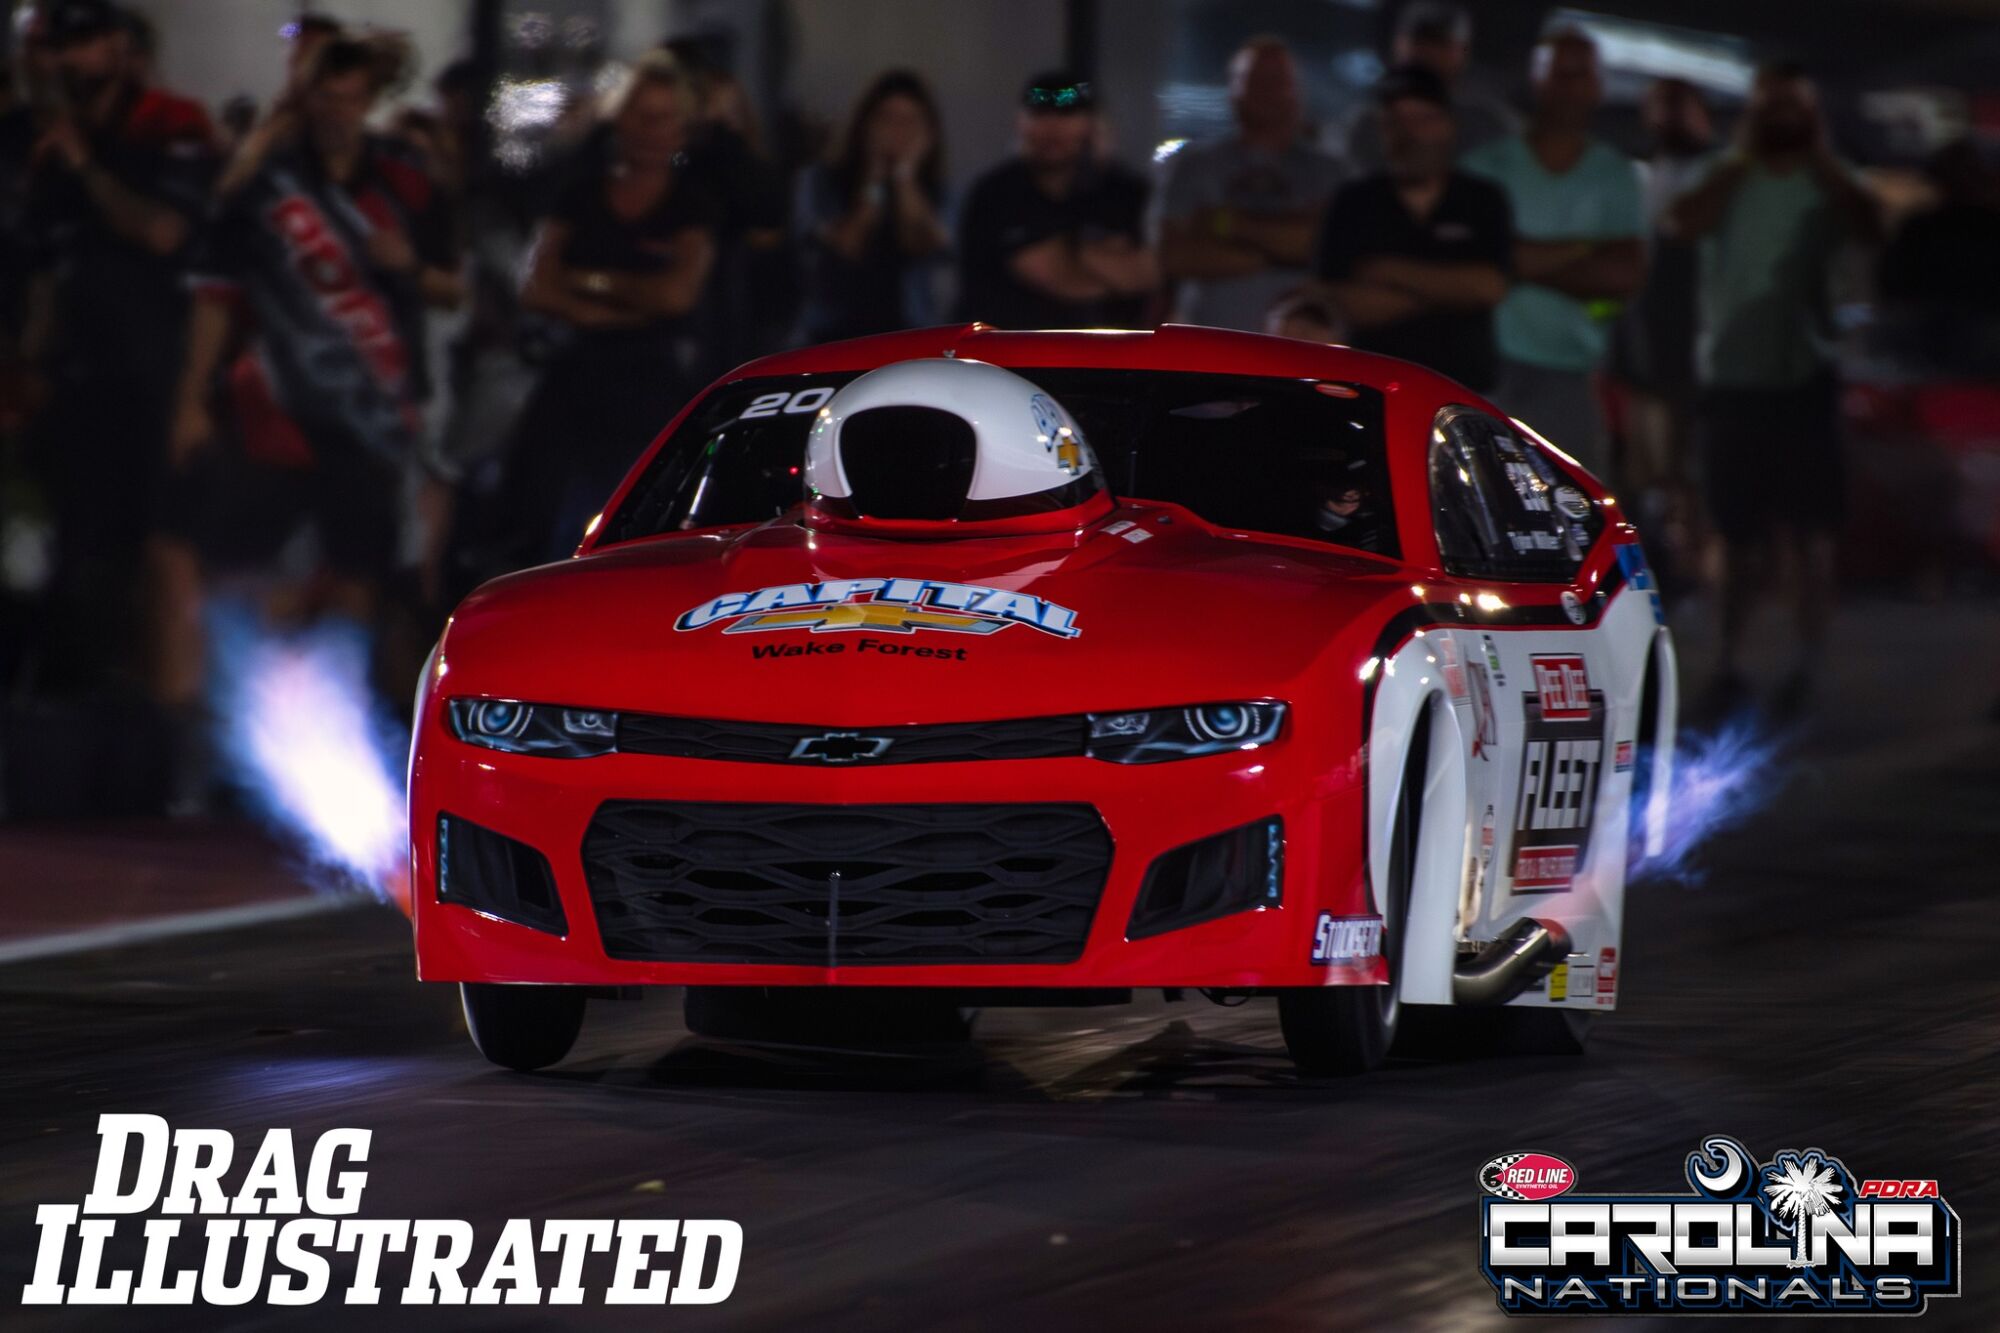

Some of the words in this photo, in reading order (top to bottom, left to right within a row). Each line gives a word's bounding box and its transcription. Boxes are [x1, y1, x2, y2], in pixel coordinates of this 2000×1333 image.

[738, 386, 836, 420] 20
[675, 579, 1081, 638] CAPITAL
[752, 640, 845, 661] Wake
[857, 638, 968, 661] Forest
